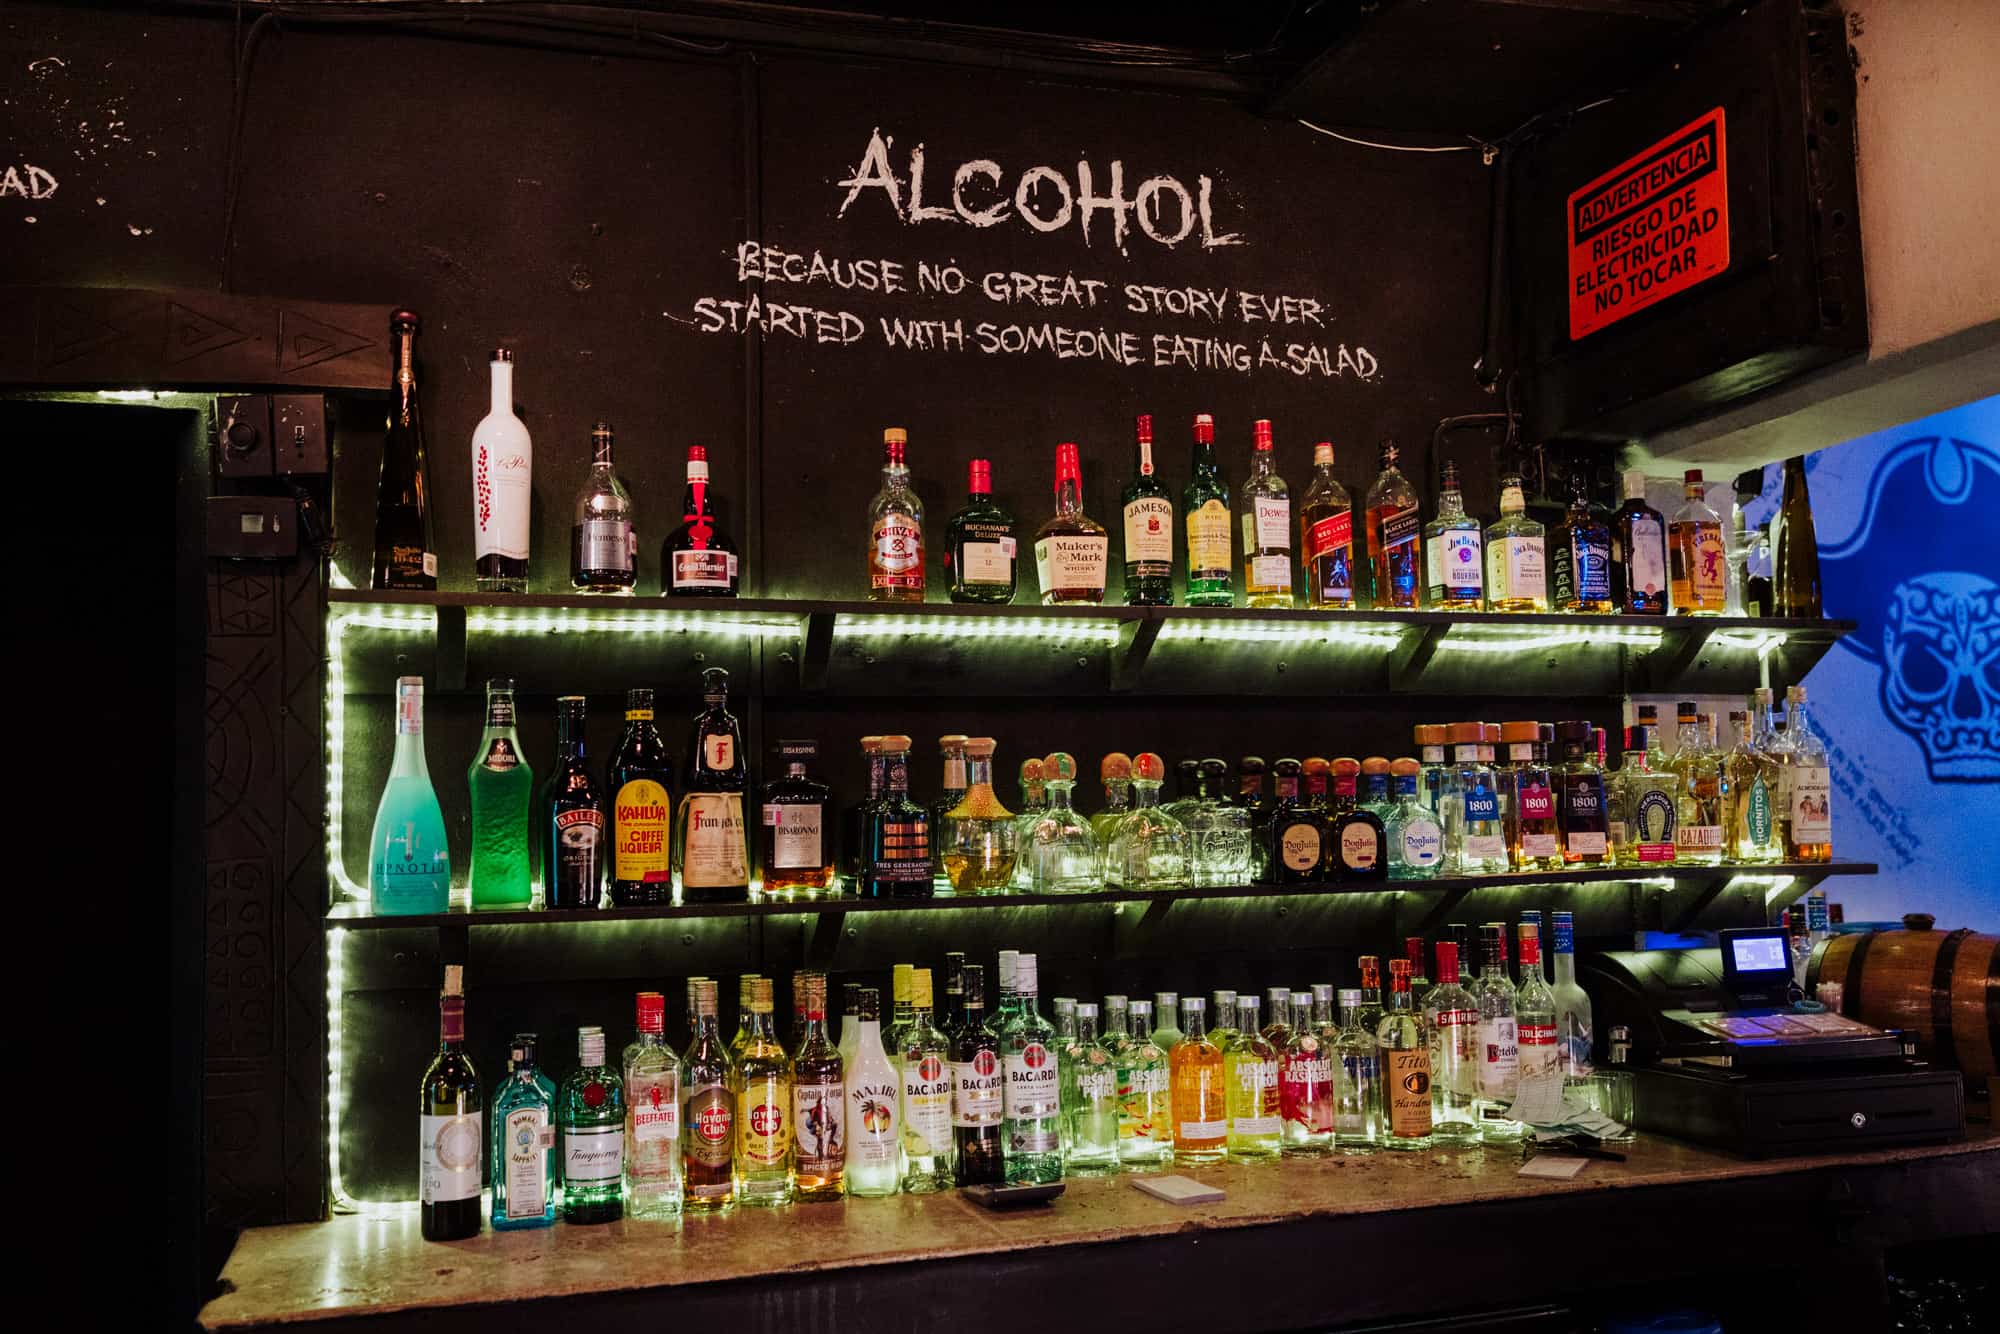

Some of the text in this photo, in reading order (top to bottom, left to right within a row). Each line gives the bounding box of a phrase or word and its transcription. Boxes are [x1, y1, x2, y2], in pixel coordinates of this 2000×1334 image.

[837, 127, 1245, 256] ALCOHOL
[1579, 140, 1709, 231] ADVERTENCIA
[1592, 188, 1697, 263] RIESGO DE
[1575, 207, 1719, 297] ELECTRICIDAD
[737, 240, 1324, 327] BECAUSE NO GREAT STORY EVER
[1594, 245, 1698, 315] NO TOCAR
[693, 295, 1378, 380] STARTED WITH SOMEONE EATING A SALAD
[879, 526, 916, 537] CHIVAS
[1056, 541, 1103, 552] Maker's
[1070, 552, 1103, 562] Mark
[906, 576, 916, 586] 12
[1469, 800, 1493, 812] 1800
[1525, 797, 1548, 809] 1800
[1572, 796, 1597, 808] 1800
[1755, 787, 1764, 845] HORNITOS
[630, 830, 664, 842] COFFEE
[620, 842, 662, 854] LIQUEUR
[762, 1046, 769, 1055] 3
[1012, 1066, 1056, 1083] BACARDÍ
[962, 1075, 1001, 1091] BACARD
[852, 1084, 897, 1104] MALIBU
[695, 1111, 732, 1124] Havana
[703, 1122, 727, 1136] Club
[569, 1148, 620, 1163] Tanqueray
